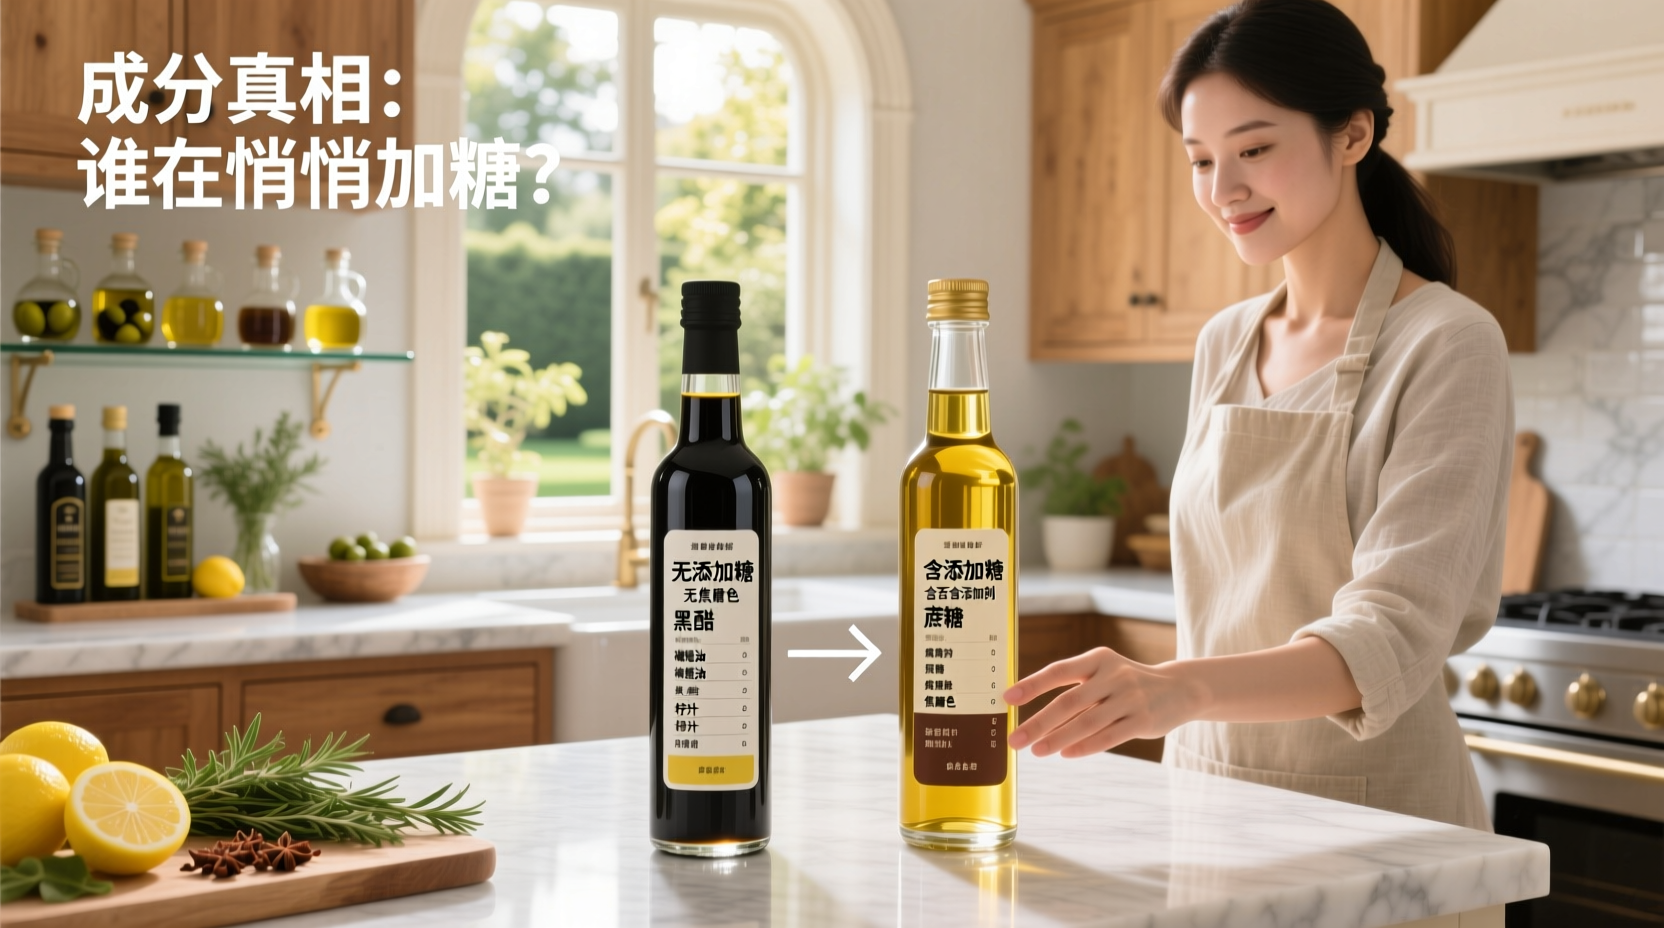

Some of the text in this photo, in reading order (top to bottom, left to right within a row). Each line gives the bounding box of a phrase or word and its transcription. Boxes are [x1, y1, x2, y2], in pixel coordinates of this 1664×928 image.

[671, 560, 754, 582] 无添加糖
[923, 559, 1004, 581] 含添加糖
[674, 608, 715, 631] 黑醋
